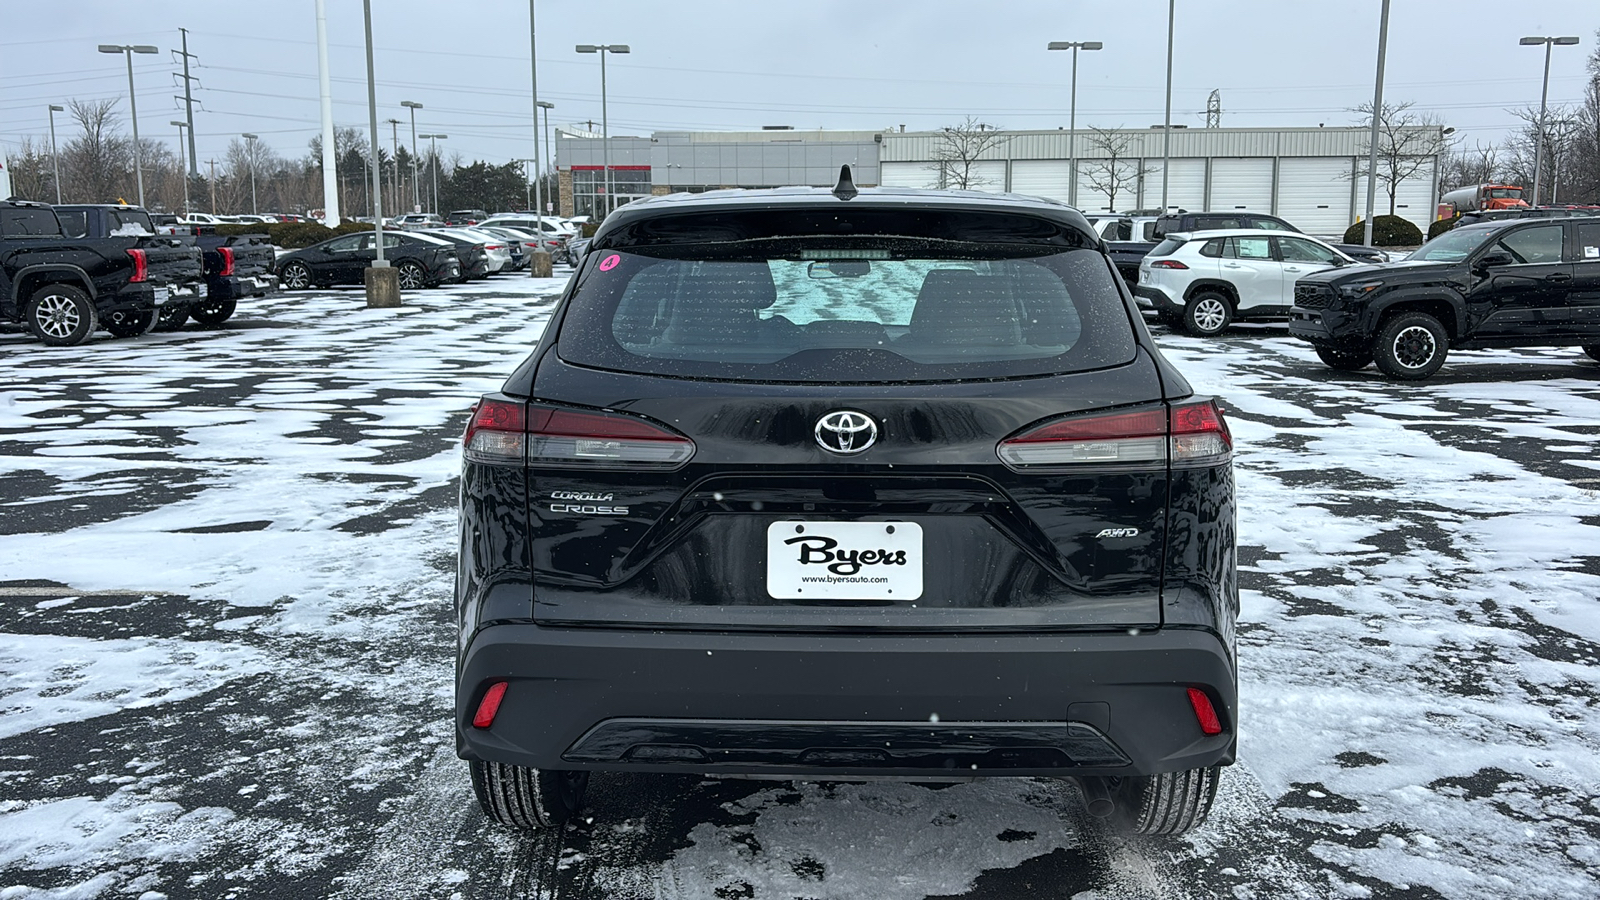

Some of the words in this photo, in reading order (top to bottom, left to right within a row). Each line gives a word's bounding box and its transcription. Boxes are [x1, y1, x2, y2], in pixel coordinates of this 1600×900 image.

[550, 490, 614, 502] COROLLA
[550, 503, 629, 515] CROSS
[1094, 527, 1139, 539] AWD
[783, 535, 907, 576] Byers
[801, 574, 889, 584] www.byersauto.com
